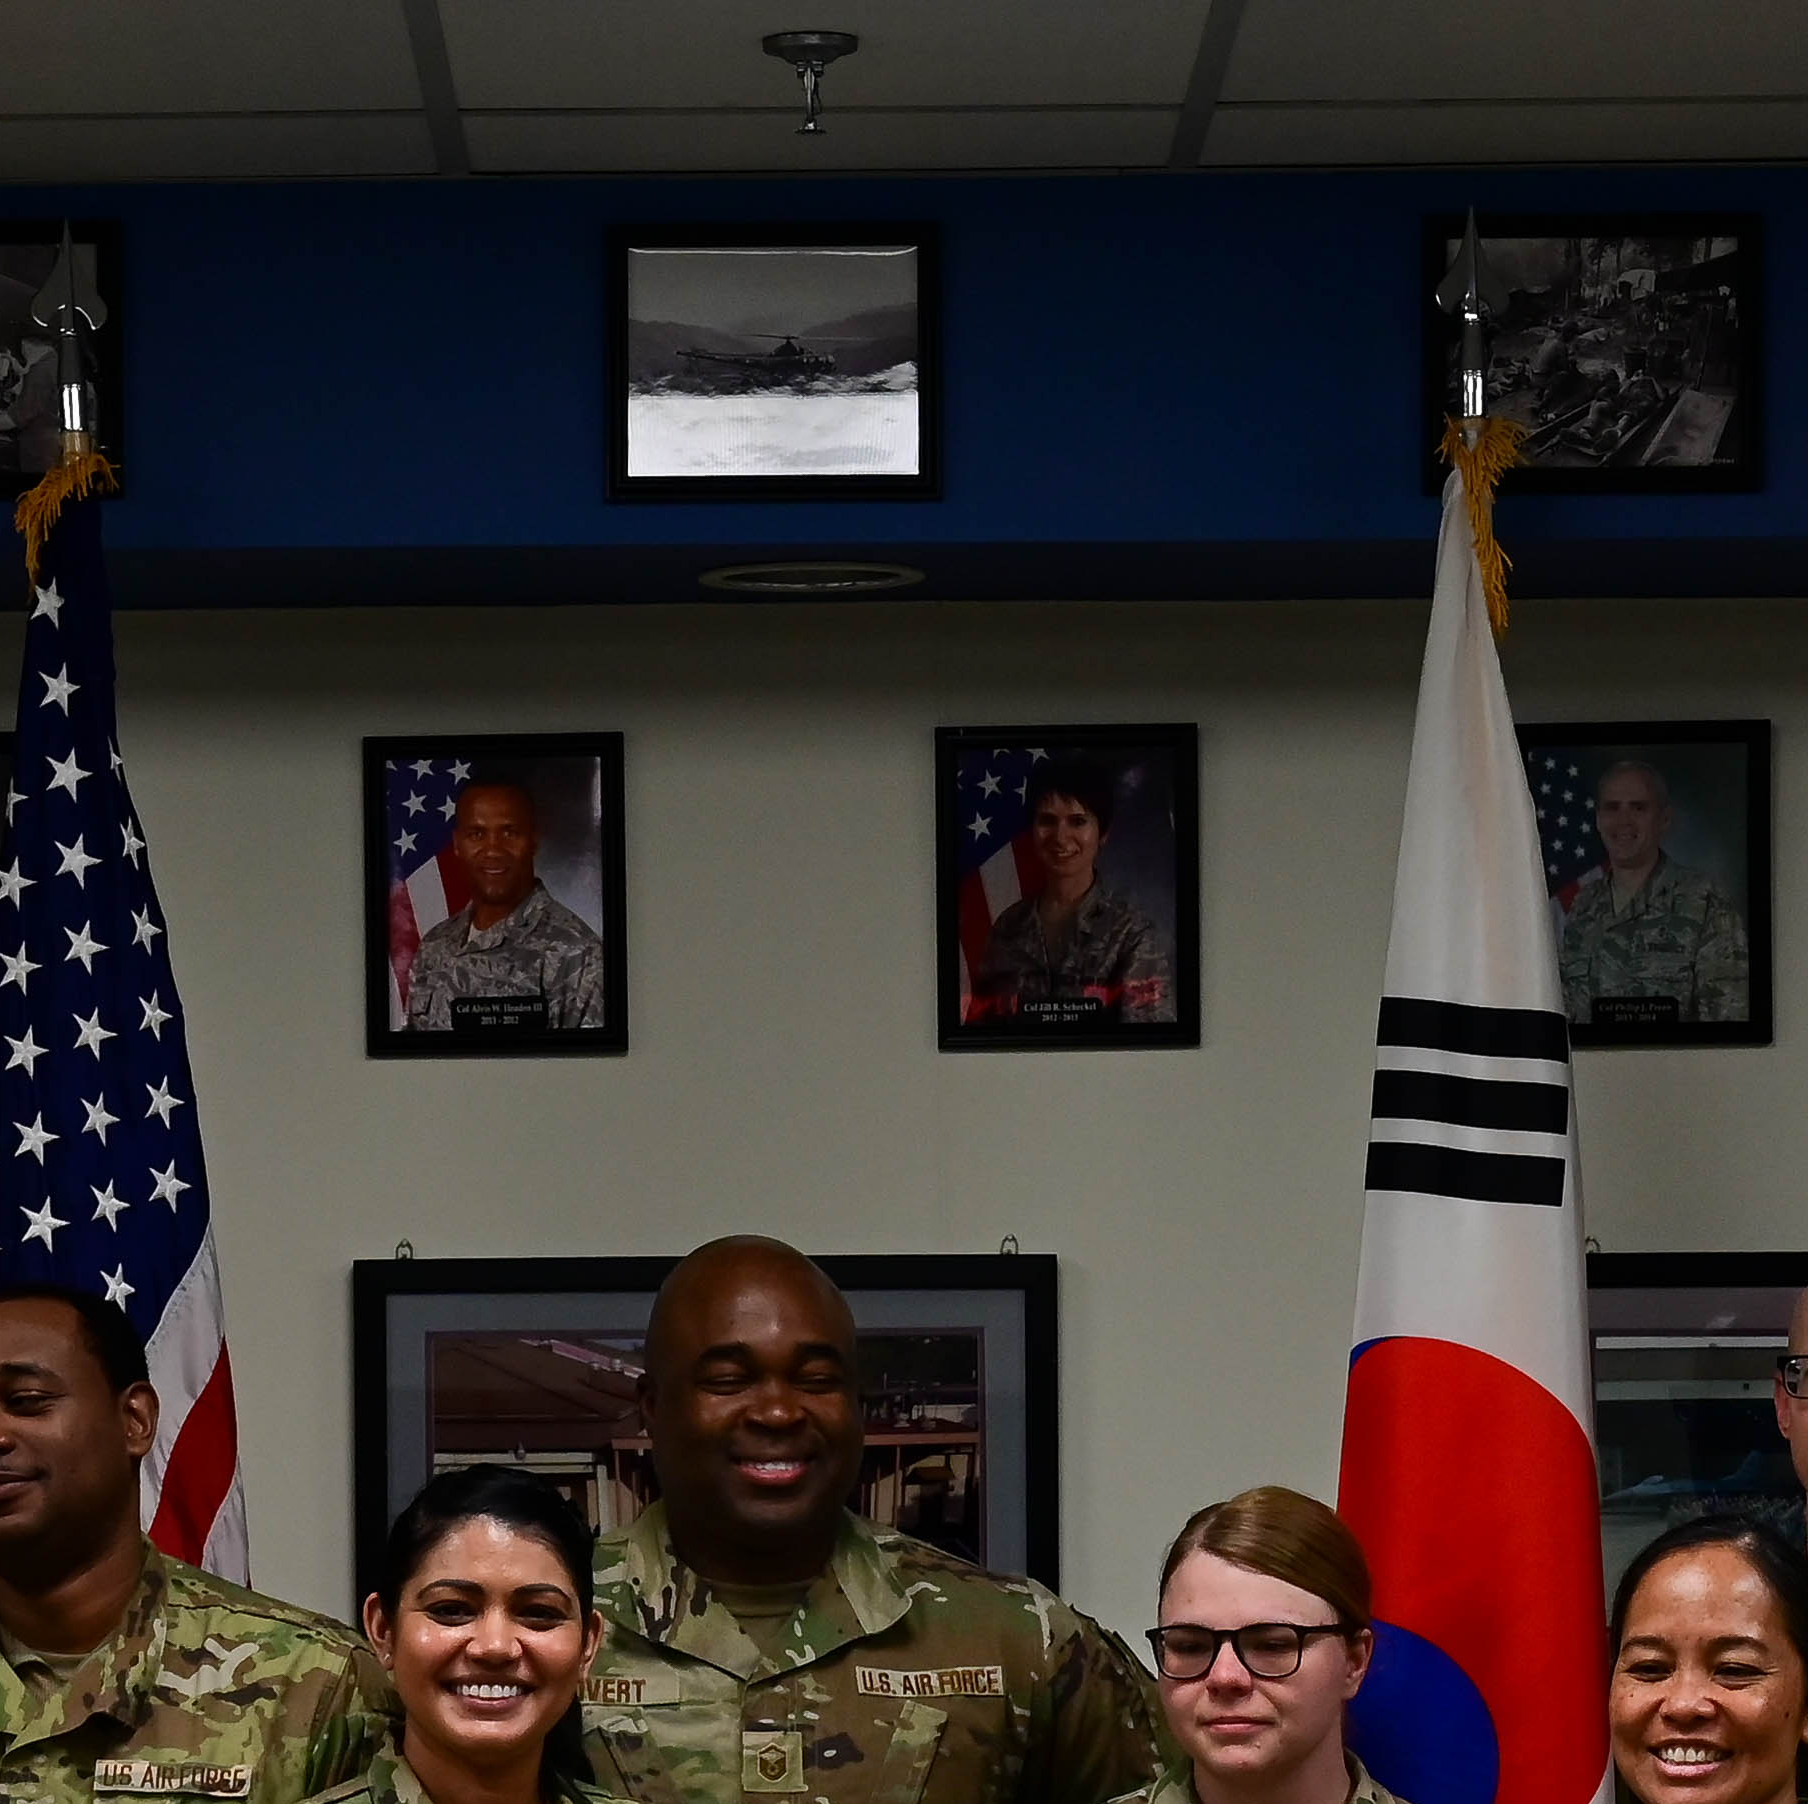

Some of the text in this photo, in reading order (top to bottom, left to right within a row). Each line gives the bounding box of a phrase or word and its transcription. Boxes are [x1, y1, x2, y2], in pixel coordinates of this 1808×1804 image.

[862, 1668, 999, 1697] U.S. AIR FORCE
[102, 1763, 247, 1795] U.S. AIR FORCE
